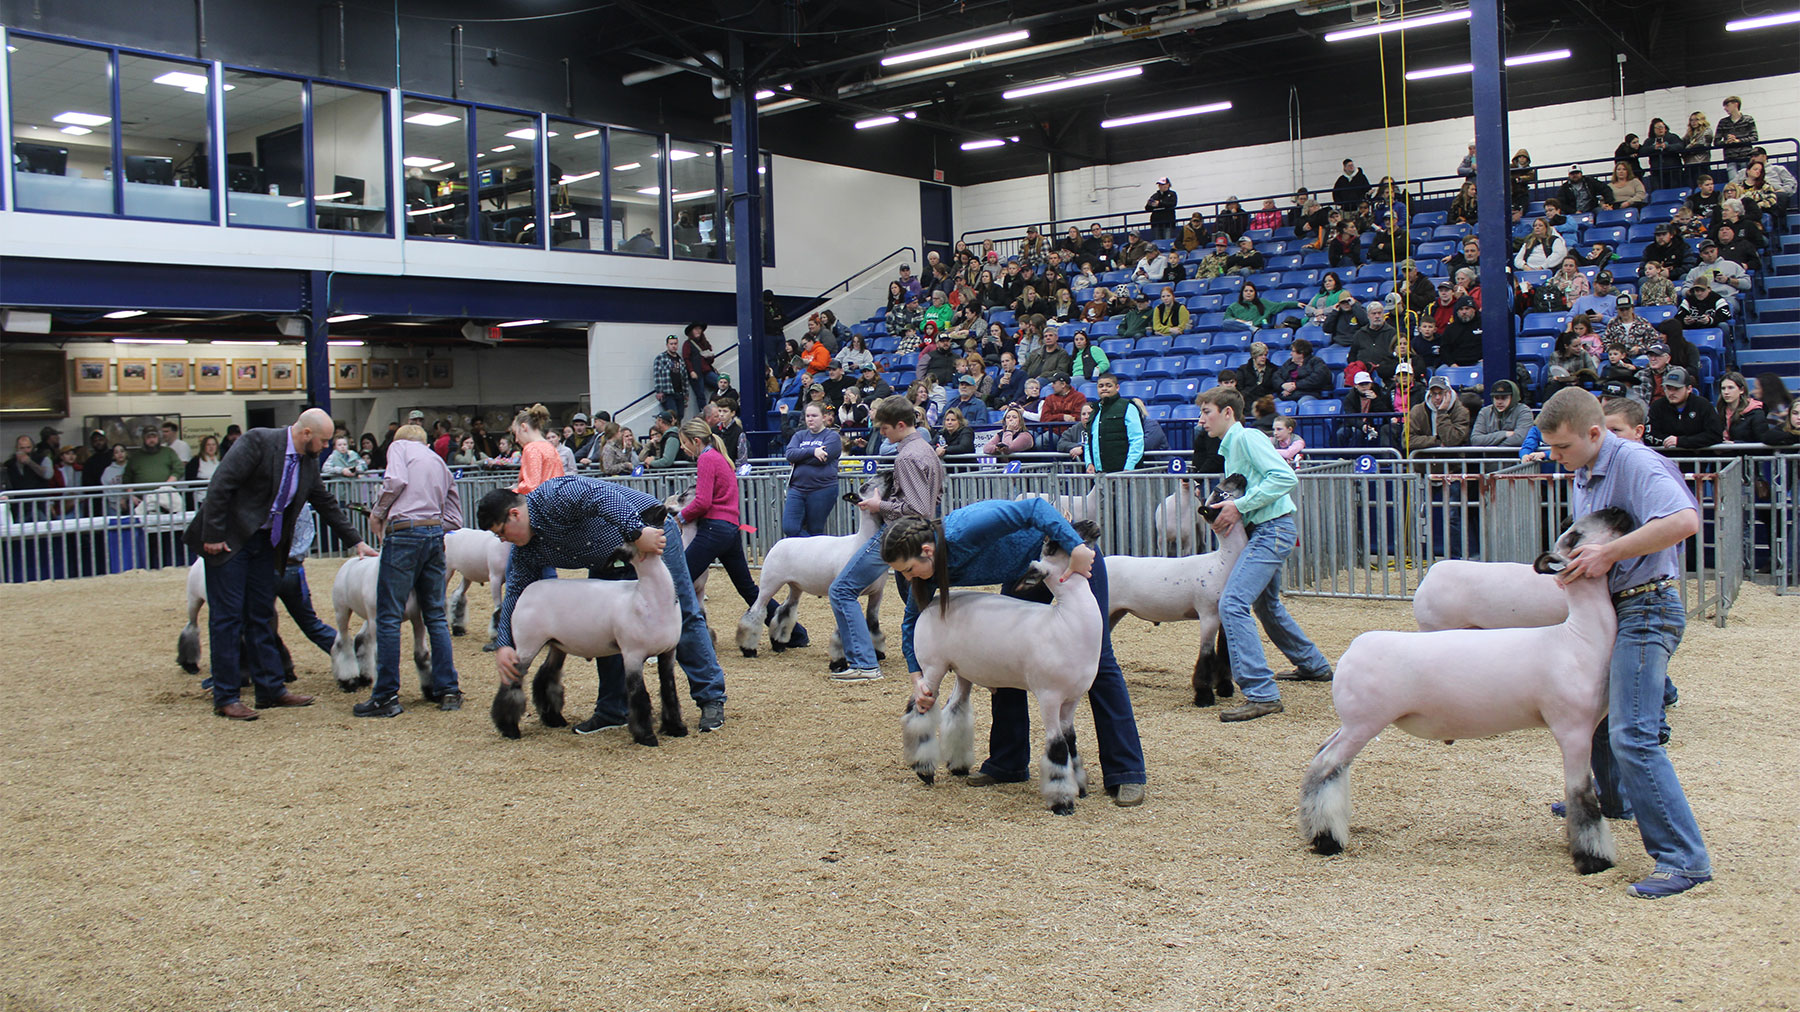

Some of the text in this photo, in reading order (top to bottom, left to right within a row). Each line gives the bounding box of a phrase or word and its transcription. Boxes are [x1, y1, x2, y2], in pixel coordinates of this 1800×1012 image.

[866, 461, 874, 472] 6
[1011, 462, 1019, 472] 7
[1172, 459, 1182, 471] 8
[1360, 457, 1371, 471] 9
[455, 470, 462, 479] 2
